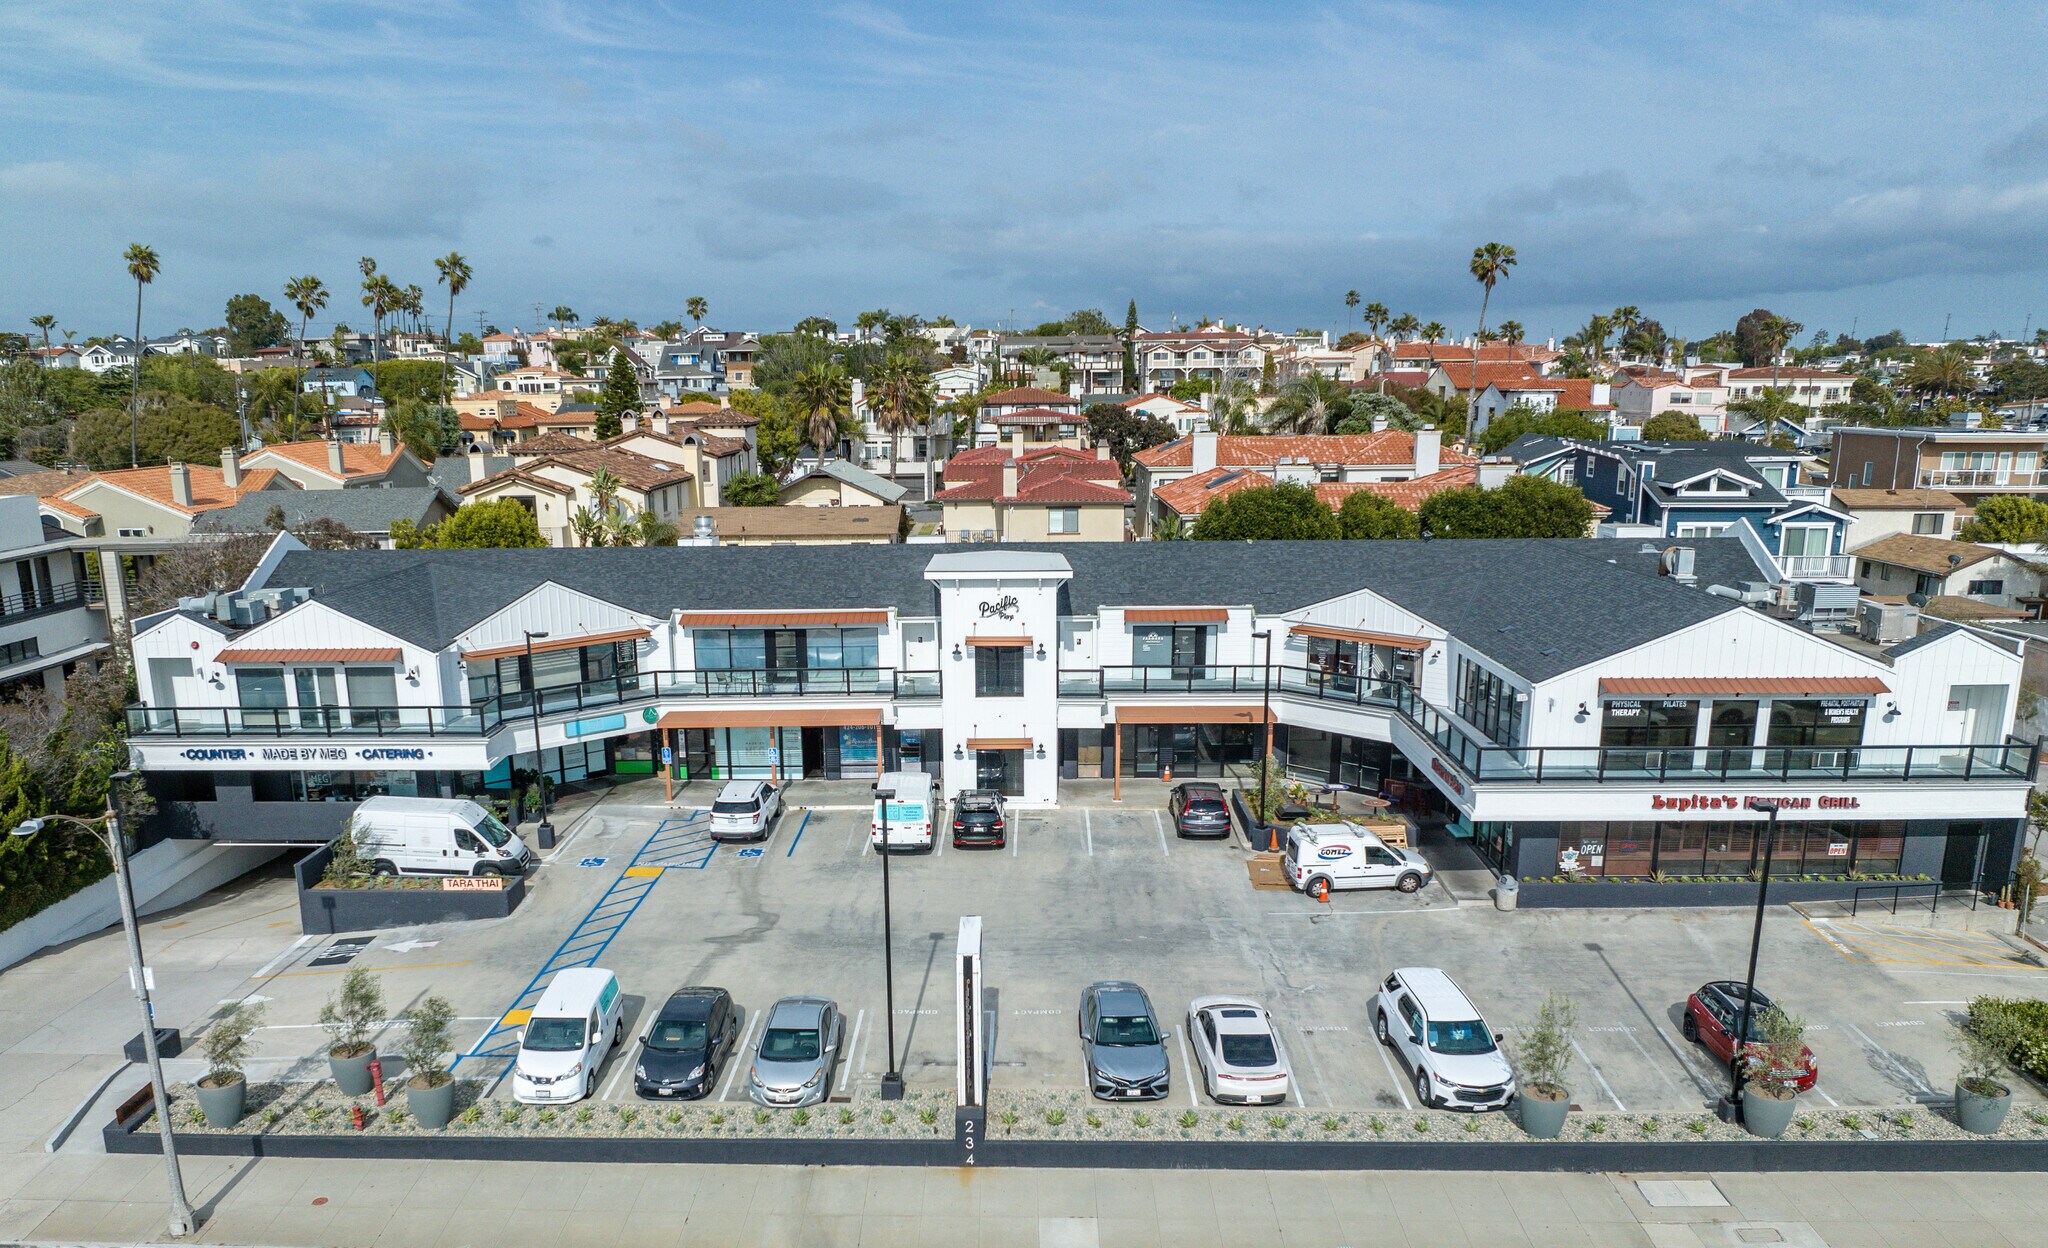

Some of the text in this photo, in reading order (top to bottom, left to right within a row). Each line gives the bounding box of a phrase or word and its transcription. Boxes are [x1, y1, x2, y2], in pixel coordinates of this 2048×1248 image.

[979, 595, 1018, 617] Pacific
[1611, 700, 1641, 708] PHYSICAL
[1663, 700, 1687, 708] PILATES
[186, 748, 425, 760] COUNTER MADE BY MEG CATERING
[1652, 794, 1738, 811] Lupita's
[1818, 796, 1860, 809] GRILL
[1320, 848, 1347, 856] GOMEZ
[1580, 844, 1604, 855] OPEN
[1829, 847, 1846, 855] OPEN
[446, 879, 499, 888] TARA THAI
[1875, 1019, 1925, 1028] COMPACT
